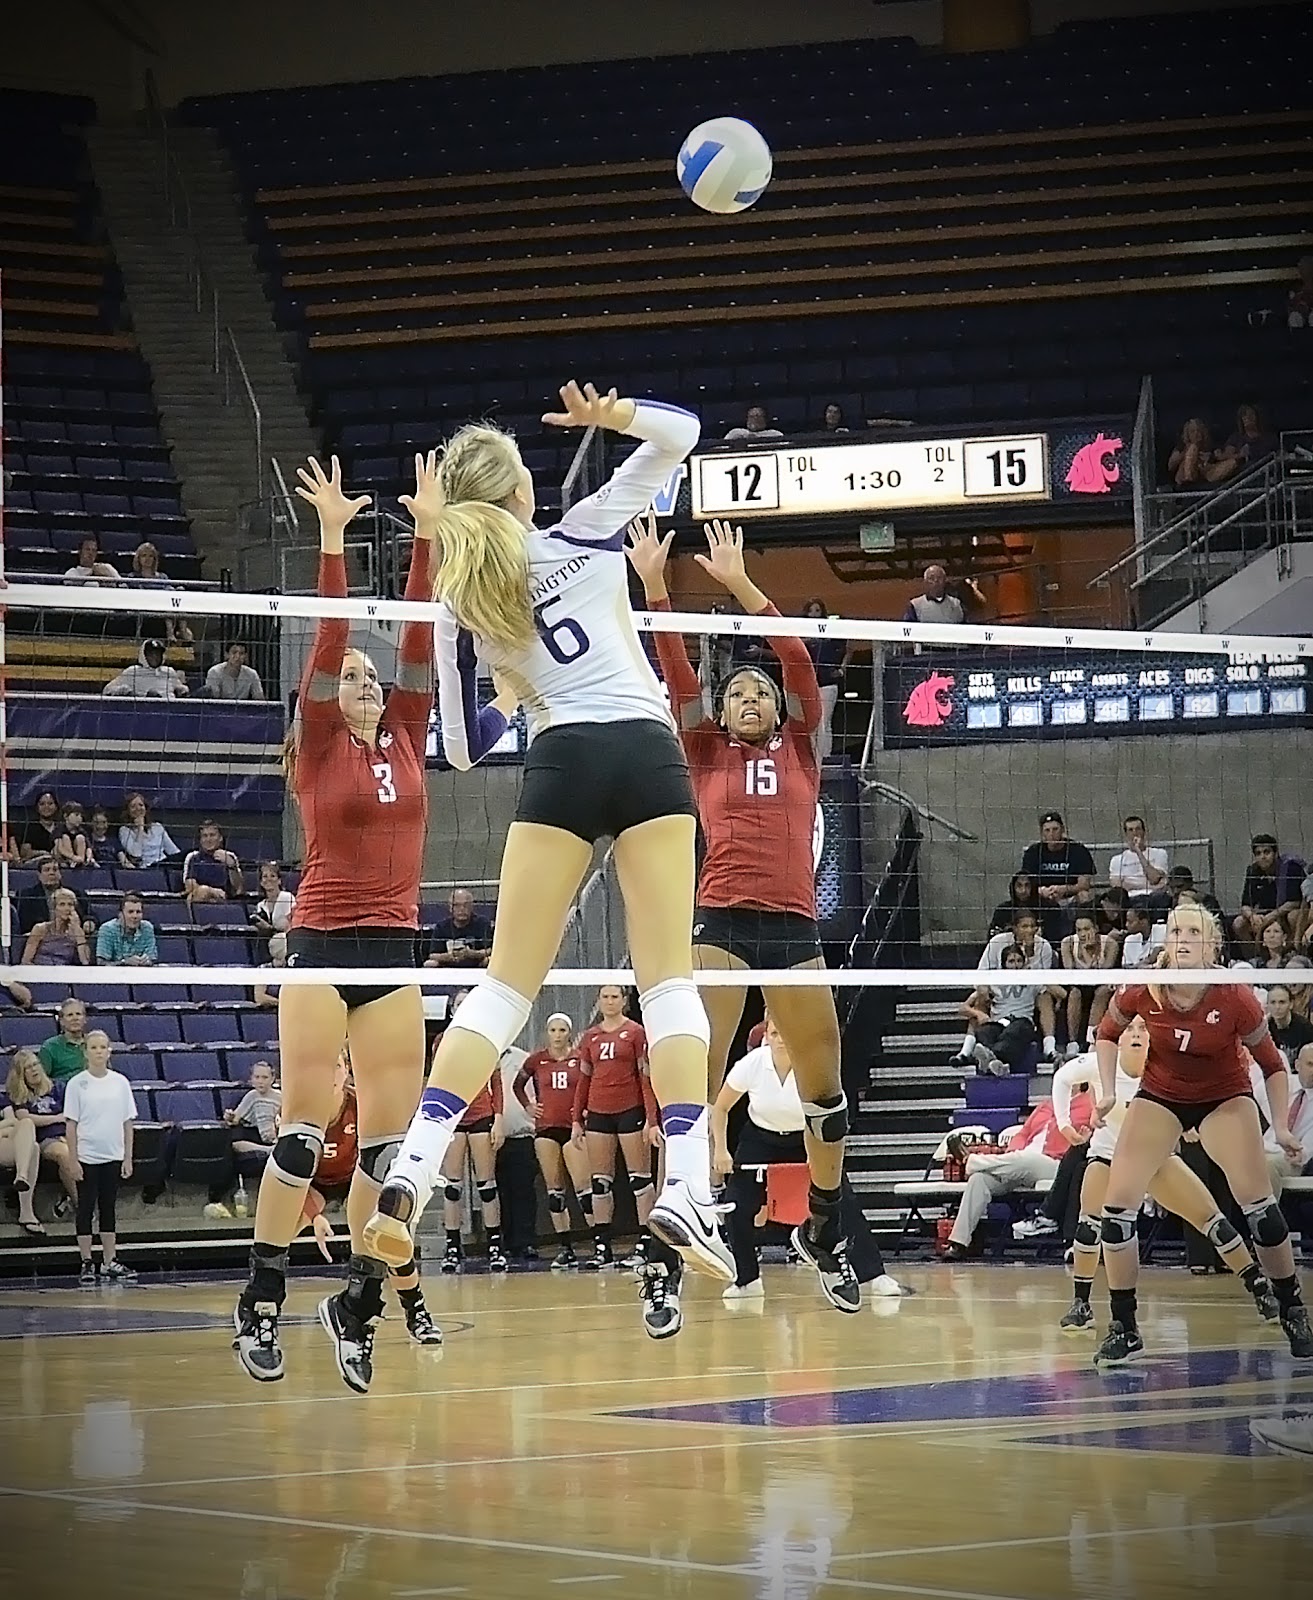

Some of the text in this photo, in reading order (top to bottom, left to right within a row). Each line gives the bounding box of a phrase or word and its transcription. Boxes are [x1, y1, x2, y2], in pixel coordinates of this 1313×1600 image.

[924, 446, 955, 463] TOL
[787, 456, 817, 473] TOL
[986, 449, 1027, 487] 15
[724, 463, 762, 502] 12
[844, 470, 902, 490] 1:30
[933, 467, 944, 483] 2
[795, 476, 803, 490] 1
[531, 554, 591, 602] INGTON
[171, 597, 182, 607] W
[269, 601, 279, 611] W
[367, 605, 377, 615] W
[533, 594, 590, 665] 6
[643, 617, 652, 627] W
[733, 621, 742, 631] W
[818, 624, 827, 633] W
[903, 627, 912, 637] W
[984, 632, 993, 641] W
[1065, 636, 1074, 645] W
[1144, 637, 1153, 646] W
[1221, 640, 1230, 649] W
[1297, 643, 1306, 653] W
[968, 673, 994, 685] SETS
[1050, 670, 1084, 683] ATTACK
[1139, 670, 1170, 686] ACES
[1185, 668, 1214, 684] DIGS
[1226, 665, 1259, 682] SOLO
[968, 685, 996, 698] WON
[1008, 677, 1041, 692] KILLS
[371, 763, 397, 803] 3
[745, 759, 778, 796] 15
[1173, 1027, 1192, 1052] 7
[600, 1042, 615, 1060] 21
[552, 1071, 568, 1089] 18
[323, 1142, 338, 1159] 5
